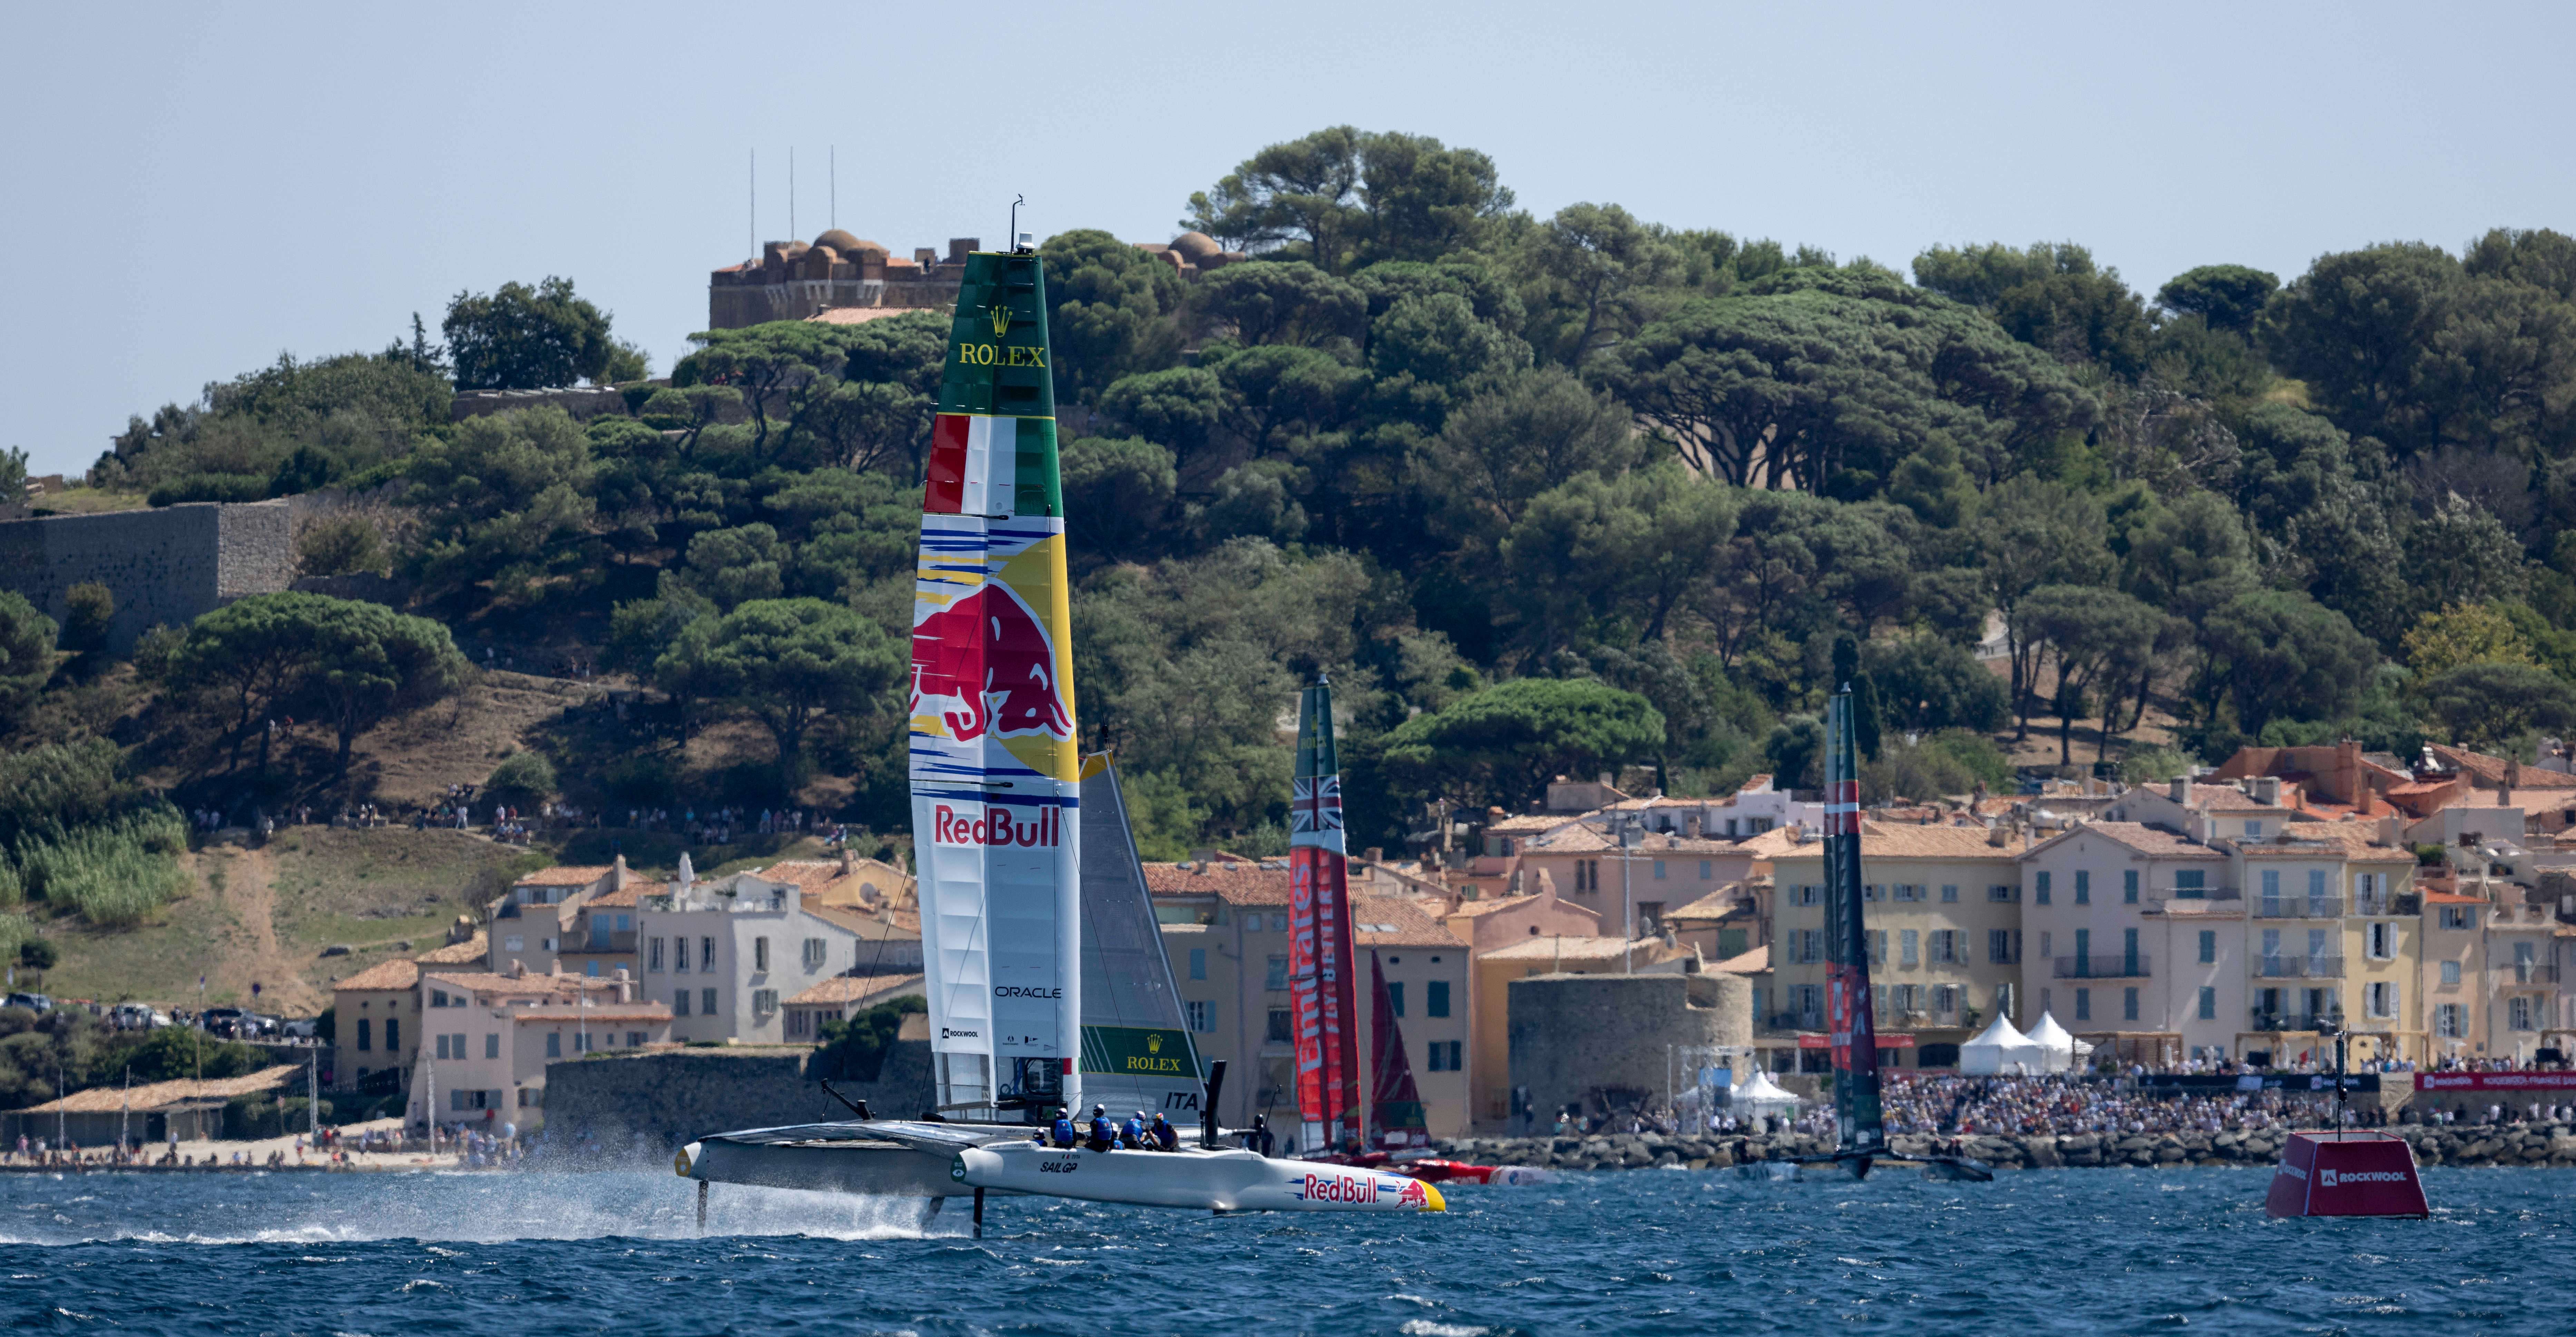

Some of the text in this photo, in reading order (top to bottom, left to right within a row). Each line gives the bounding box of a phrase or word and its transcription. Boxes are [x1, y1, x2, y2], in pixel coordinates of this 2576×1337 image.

[960, 343, 1045, 367] ROLEX
[1293, 862, 1322, 1074] Emirates
[995, 986, 1061, 999] ORACLE
[1127, 1056, 1180, 1071] ROLEX
[1165, 1092, 1198, 1111] ITA
[2340, 1172, 2407, 1182] ROCKWOOL
